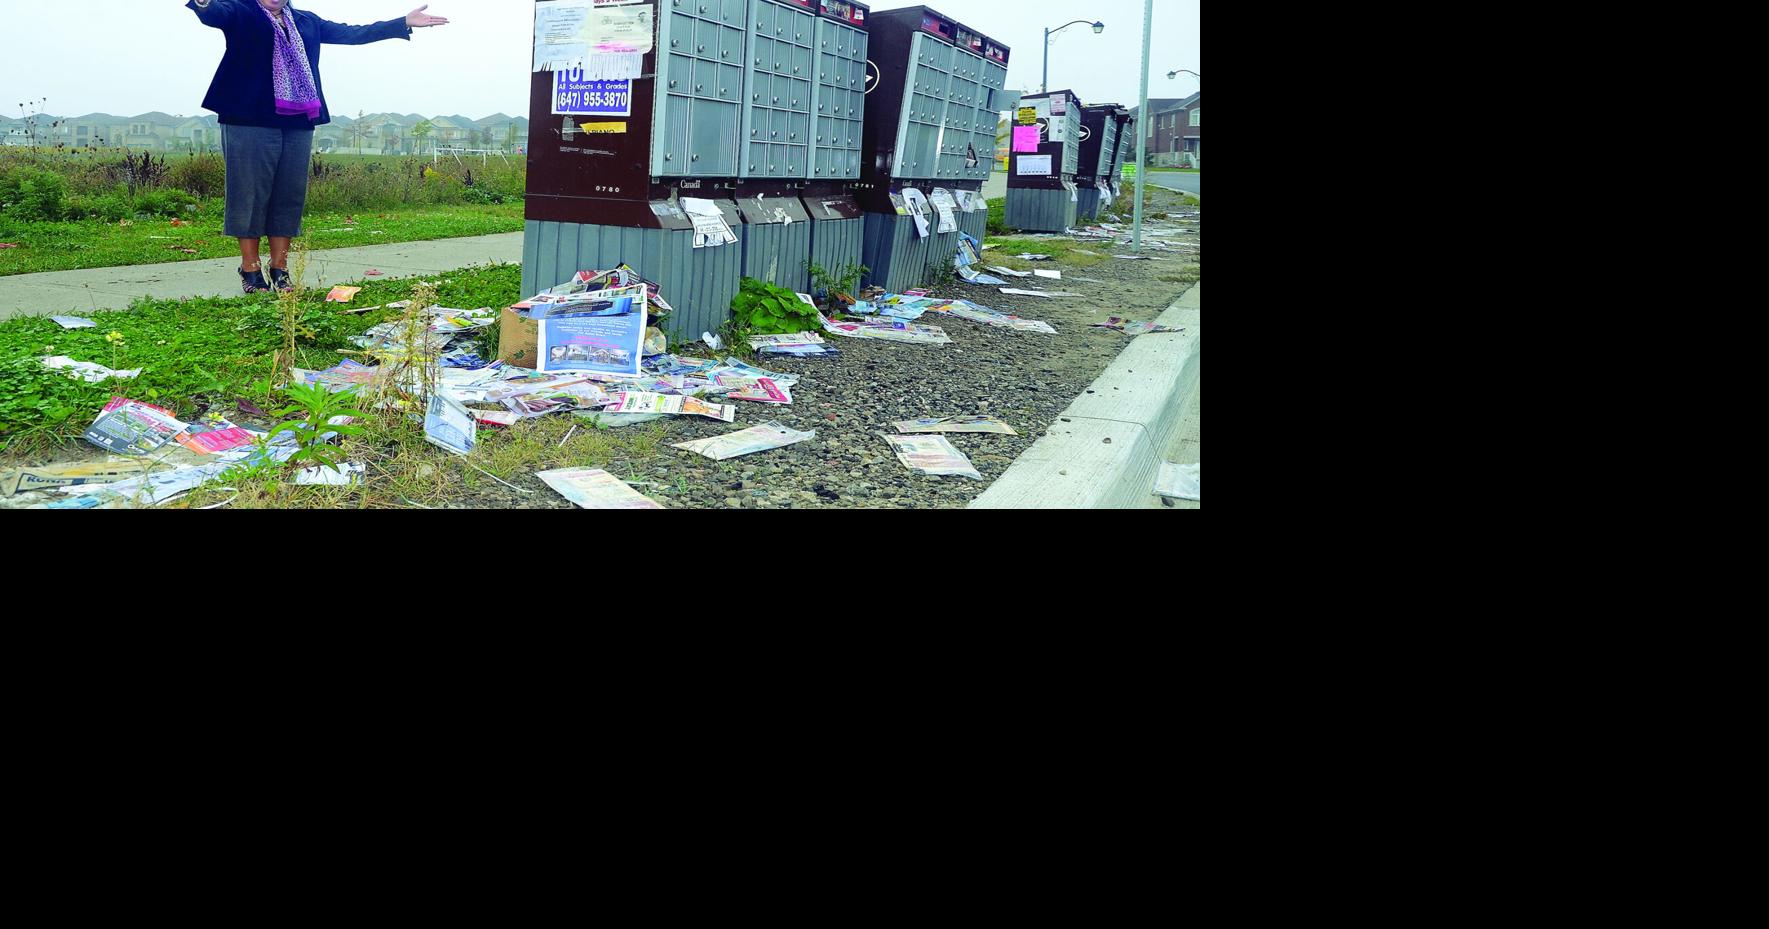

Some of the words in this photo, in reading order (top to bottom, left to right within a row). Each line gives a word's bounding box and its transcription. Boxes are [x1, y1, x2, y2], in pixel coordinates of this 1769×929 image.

[558, 91, 580, 110] (647)
[583, 91, 627, 107] 955-3870
[595, 185, 620, 193] 0780
